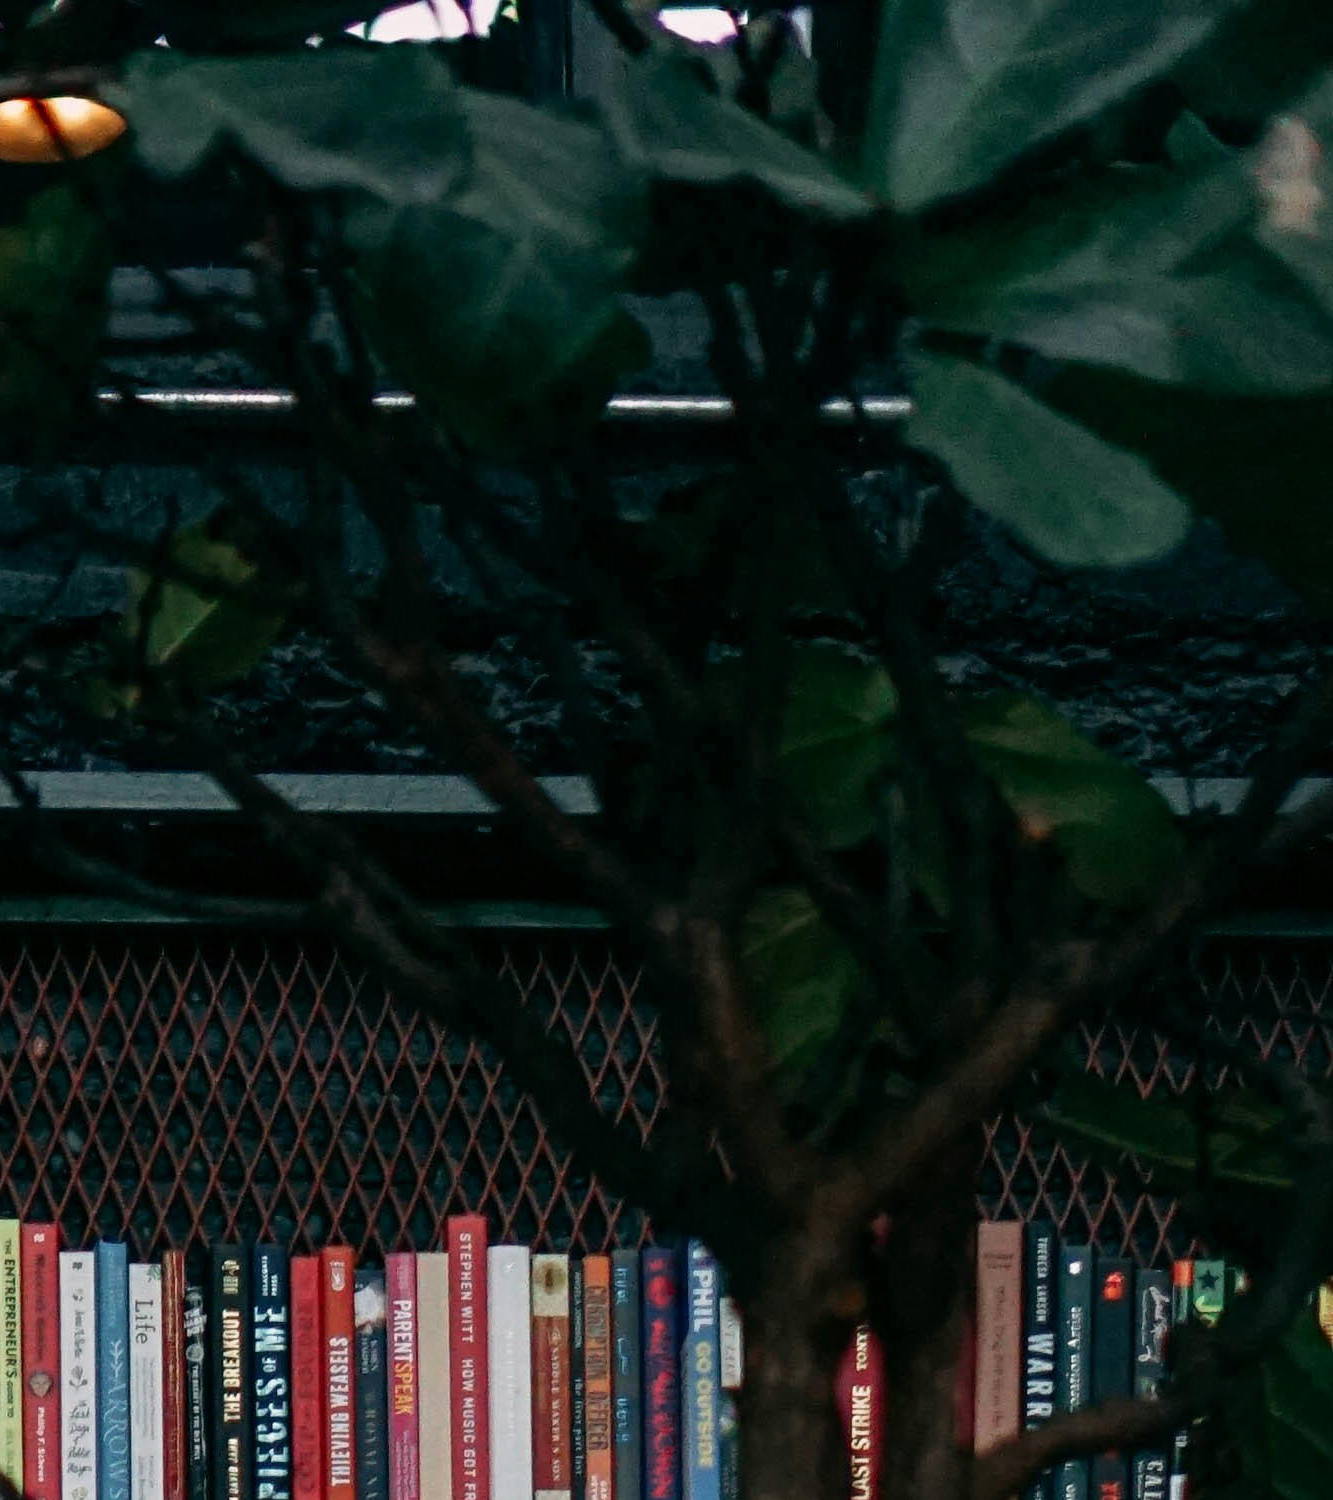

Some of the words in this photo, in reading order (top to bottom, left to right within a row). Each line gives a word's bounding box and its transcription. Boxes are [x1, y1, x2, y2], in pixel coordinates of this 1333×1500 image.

[460, 1233, 472, 1300] STEPHEN
[134, 1300, 154, 1344] Life
[461, 1307, 473, 1344] WITT
[222, 1309, 239, 1387] BREAKOUT
[329, 1336, 349, 1408] WEASELS
[461, 1359, 474, 1390] HOW
[223, 1393, 240, 1422] THE
[462, 1397, 475, 1443] MUSIC
[330, 1414, 350, 1485] THIEVING
[463, 1449, 476, 1477] GOT
